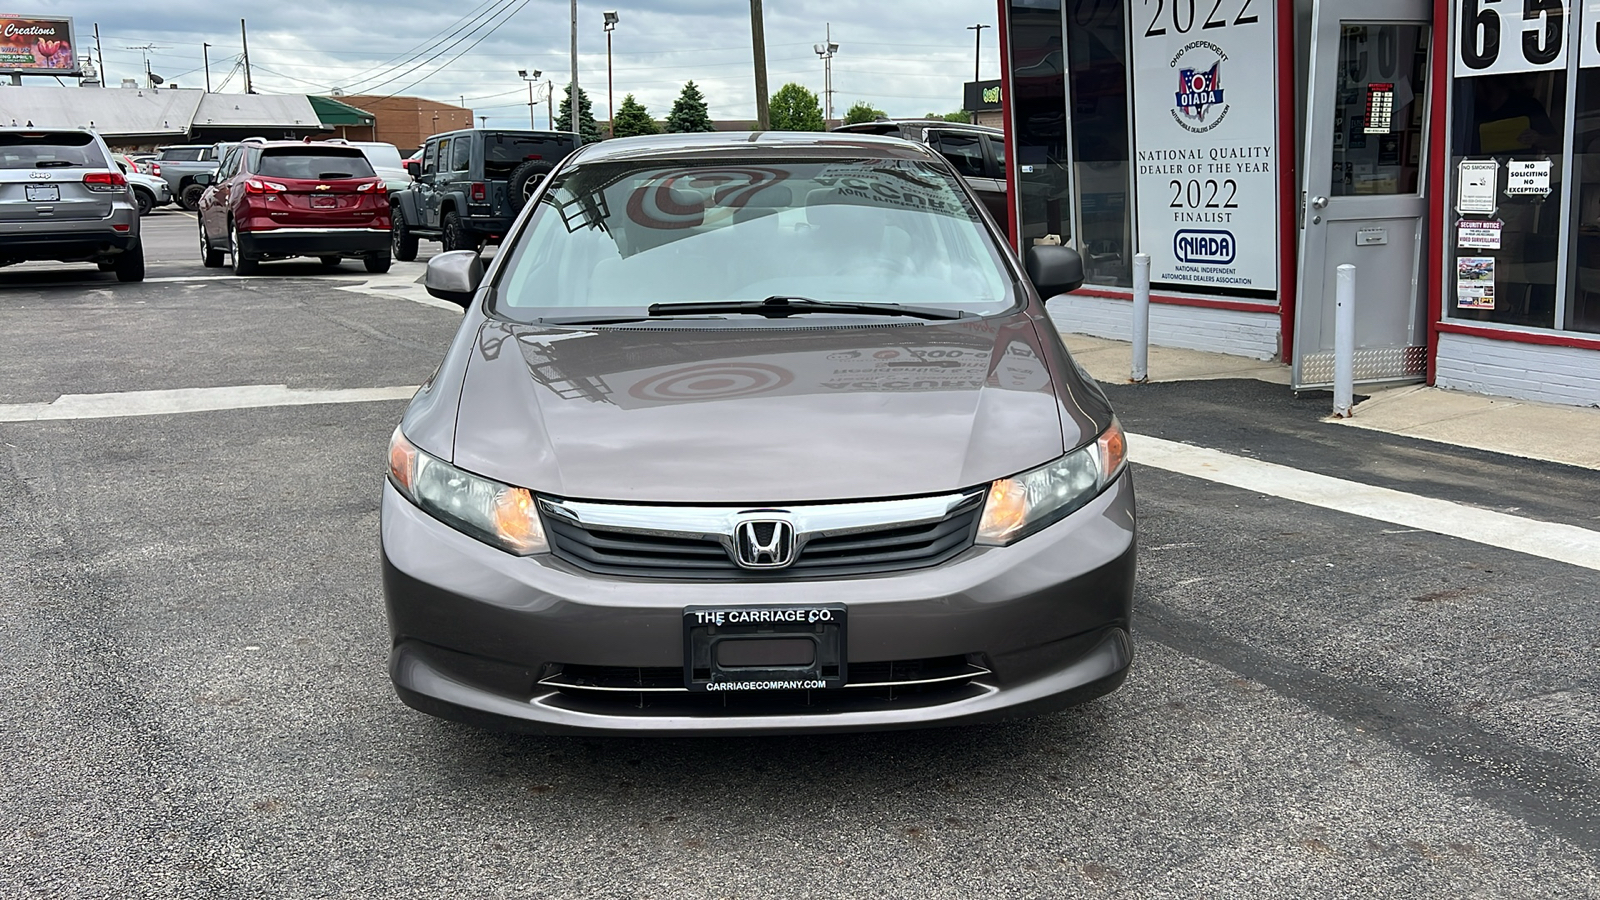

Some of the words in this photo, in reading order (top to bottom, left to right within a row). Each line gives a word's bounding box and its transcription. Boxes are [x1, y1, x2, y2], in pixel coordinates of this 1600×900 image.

[1144, 0, 1258, 38] 2022
[4, 23, 56, 37] Creations
[1170, 48, 1184, 68] OHIO
[1184, 40, 1229, 62] INDEPENDENT
[1181, 92, 1216, 106] OIADA
[1170, 108, 1190, 132] AUTOMOBILE
[1208, 104, 1230, 131] ASSOCIATION
[1138, 149, 1204, 161] NATIONAL
[1209, 146, 1271, 160] QUALITY
[1140, 164, 1183, 174] DEALER
[1188, 164, 1202, 174] OF
[1208, 163, 1231, 173] THE
[1236, 162, 1270, 172] YEAR
[1169, 179, 1238, 208] 2022
[1174, 212, 1232, 222] FINALIST
[1179, 236, 1230, 257] NIADA
[1201, 267, 1236, 275] INDEPENDENT
[1161, 273, 1192, 281] AUTOMOBILE
[1216, 276, 1252, 285] ASSOCIATION
[695, 612, 725, 624] THE
[728, 610, 806, 622] CARRIAGE
[808, 609, 834, 622] CO.
[706, 680, 826, 691] CARRIAGECOMPANY.COM
